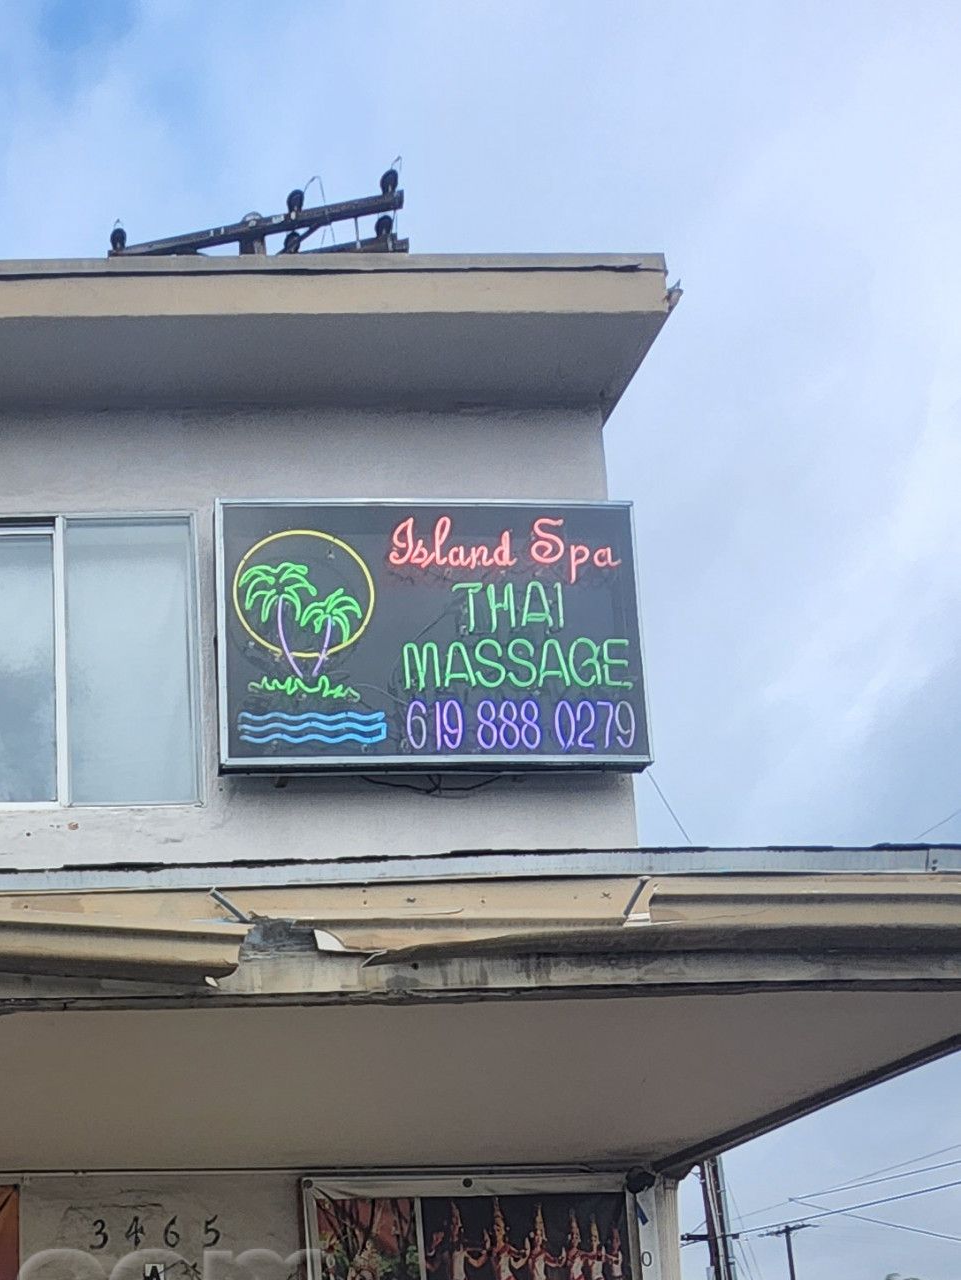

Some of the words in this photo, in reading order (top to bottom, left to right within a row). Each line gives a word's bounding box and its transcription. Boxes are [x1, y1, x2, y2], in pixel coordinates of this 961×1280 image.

[388, 516, 517, 569] Island
[530, 517, 621, 583] Spa
[452, 581, 564, 632] THAI
[403, 637, 634, 691] MASSAGE
[406, 700, 463, 750] 619
[476, 700, 541, 750] 888
[554, 700, 635, 751] 0279
[89, 1215, 221, 1249] 3465
